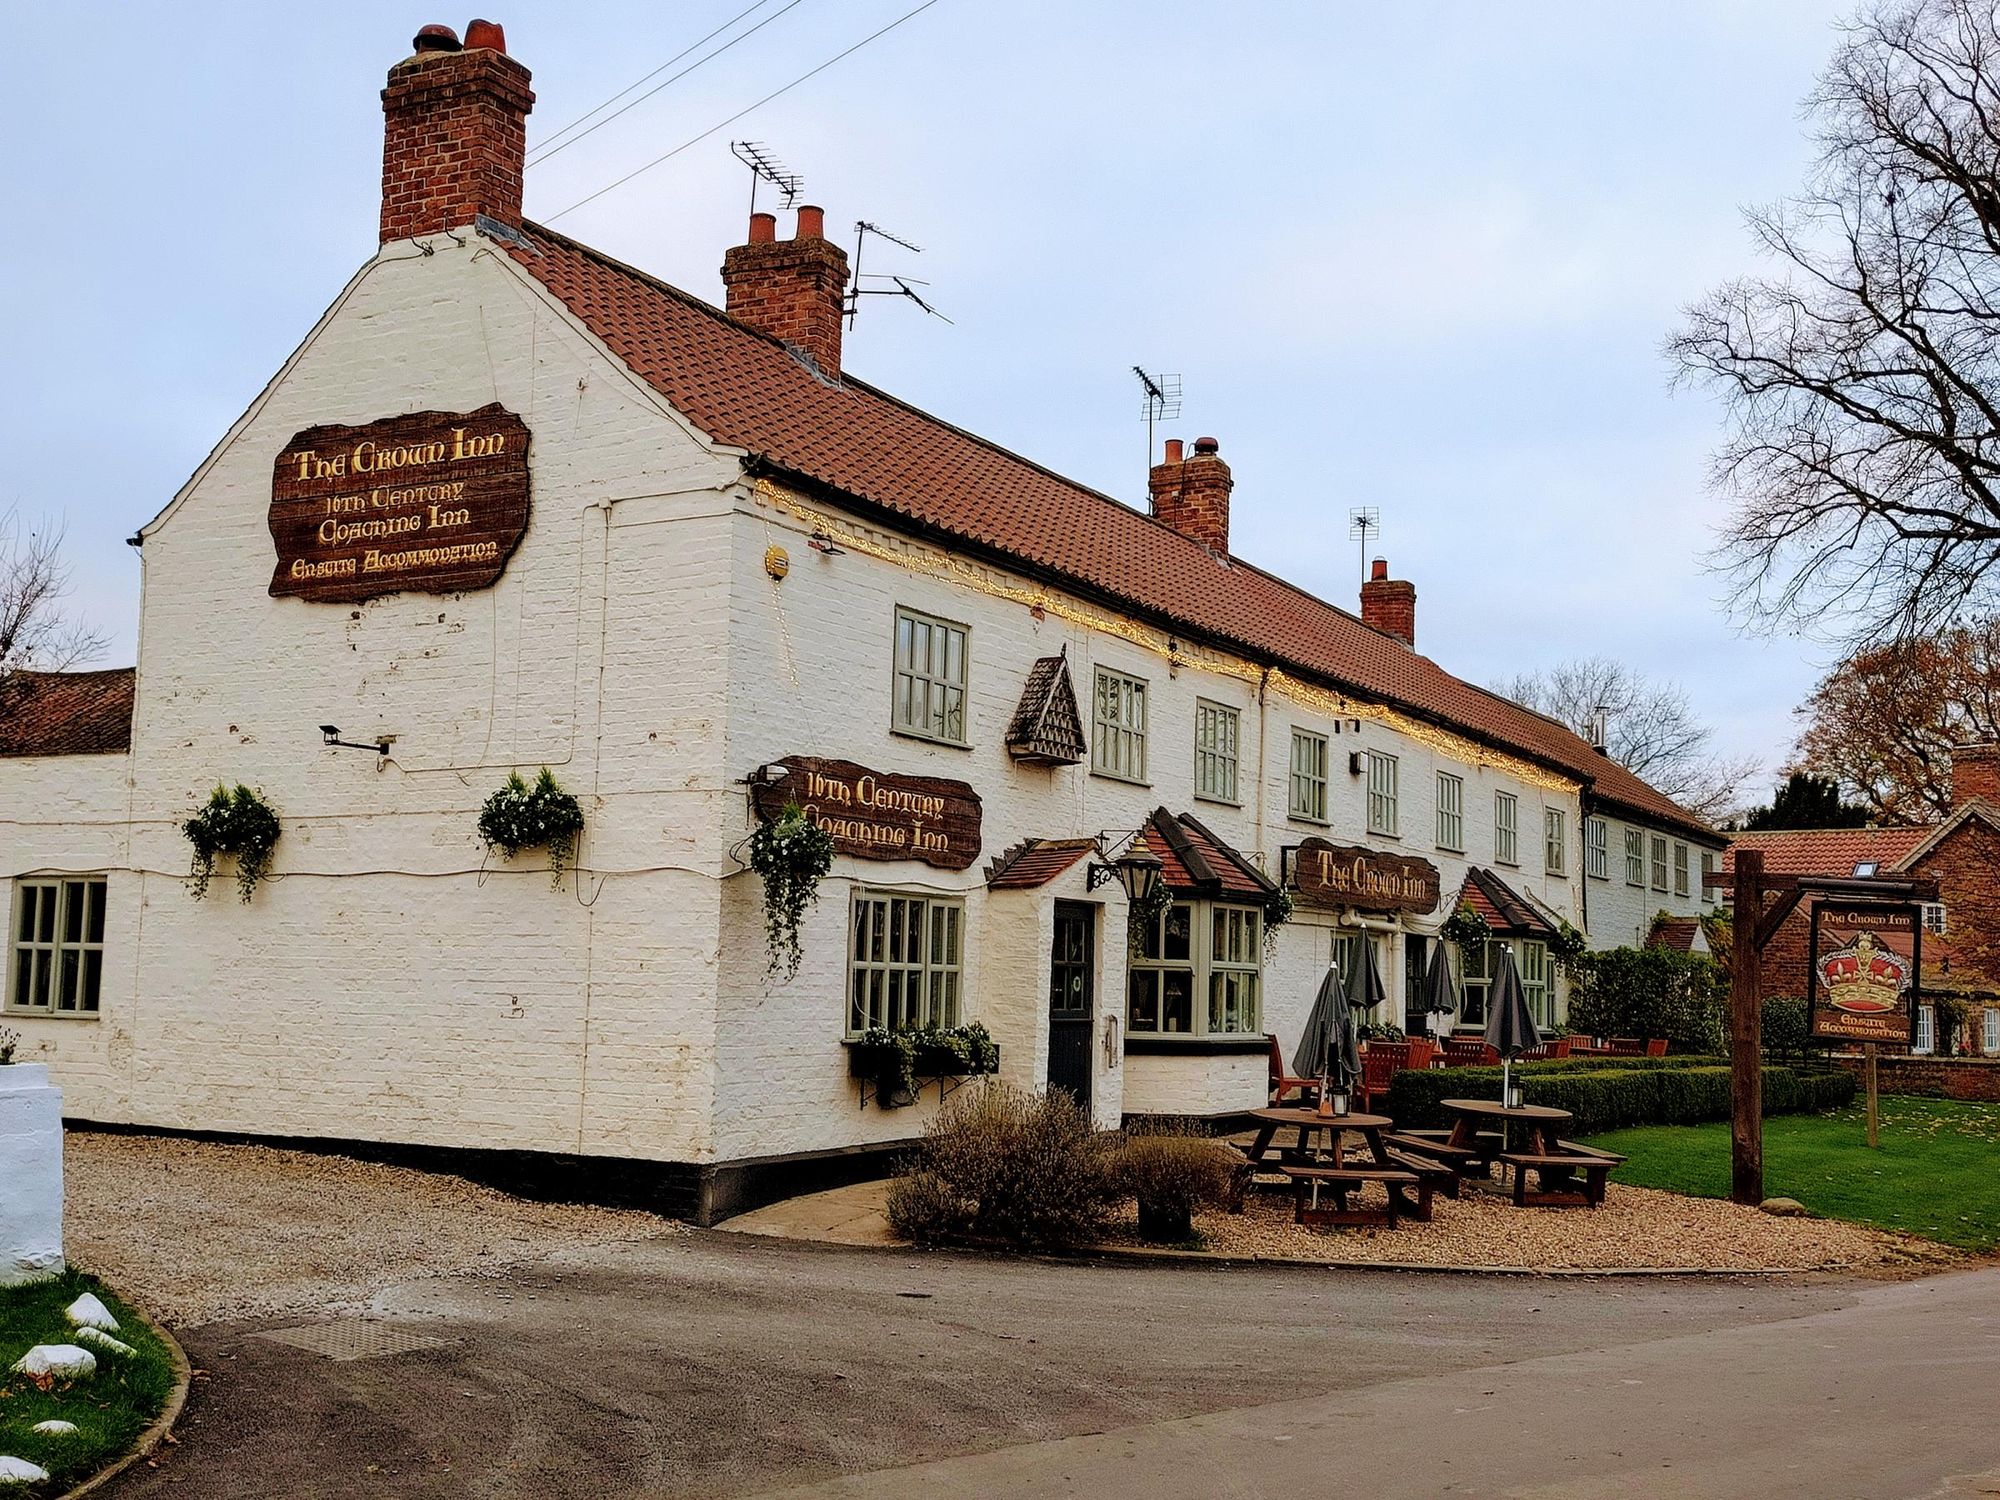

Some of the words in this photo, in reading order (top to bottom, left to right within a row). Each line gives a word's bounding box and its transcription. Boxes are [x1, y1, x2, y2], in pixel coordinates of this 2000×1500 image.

[294, 450, 346, 482] The
[352, 441, 445, 475] Crown
[450, 427, 505, 462] Inn
[326, 496, 366, 517] 16th
[372, 482, 464, 510] Century
[319, 519, 422, 545] Coaching
[426, 503, 472, 530] Inn
[291, 558, 357, 580] Ensuite
[362, 541, 499, 574] Accommodation
[807, 771, 852, 807] 16th
[856, 775, 945, 821] Century
[911, 819, 949, 853] Inn
[1317, 850, 1350, 892] The
[1353, 856, 1400, 899] Crown
[1402, 865, 1426, 899] Inn
[1821, 911, 1845, 924] The
[1847, 912, 1886, 925] Crown
[1887, 913, 1910, 926] Inn
